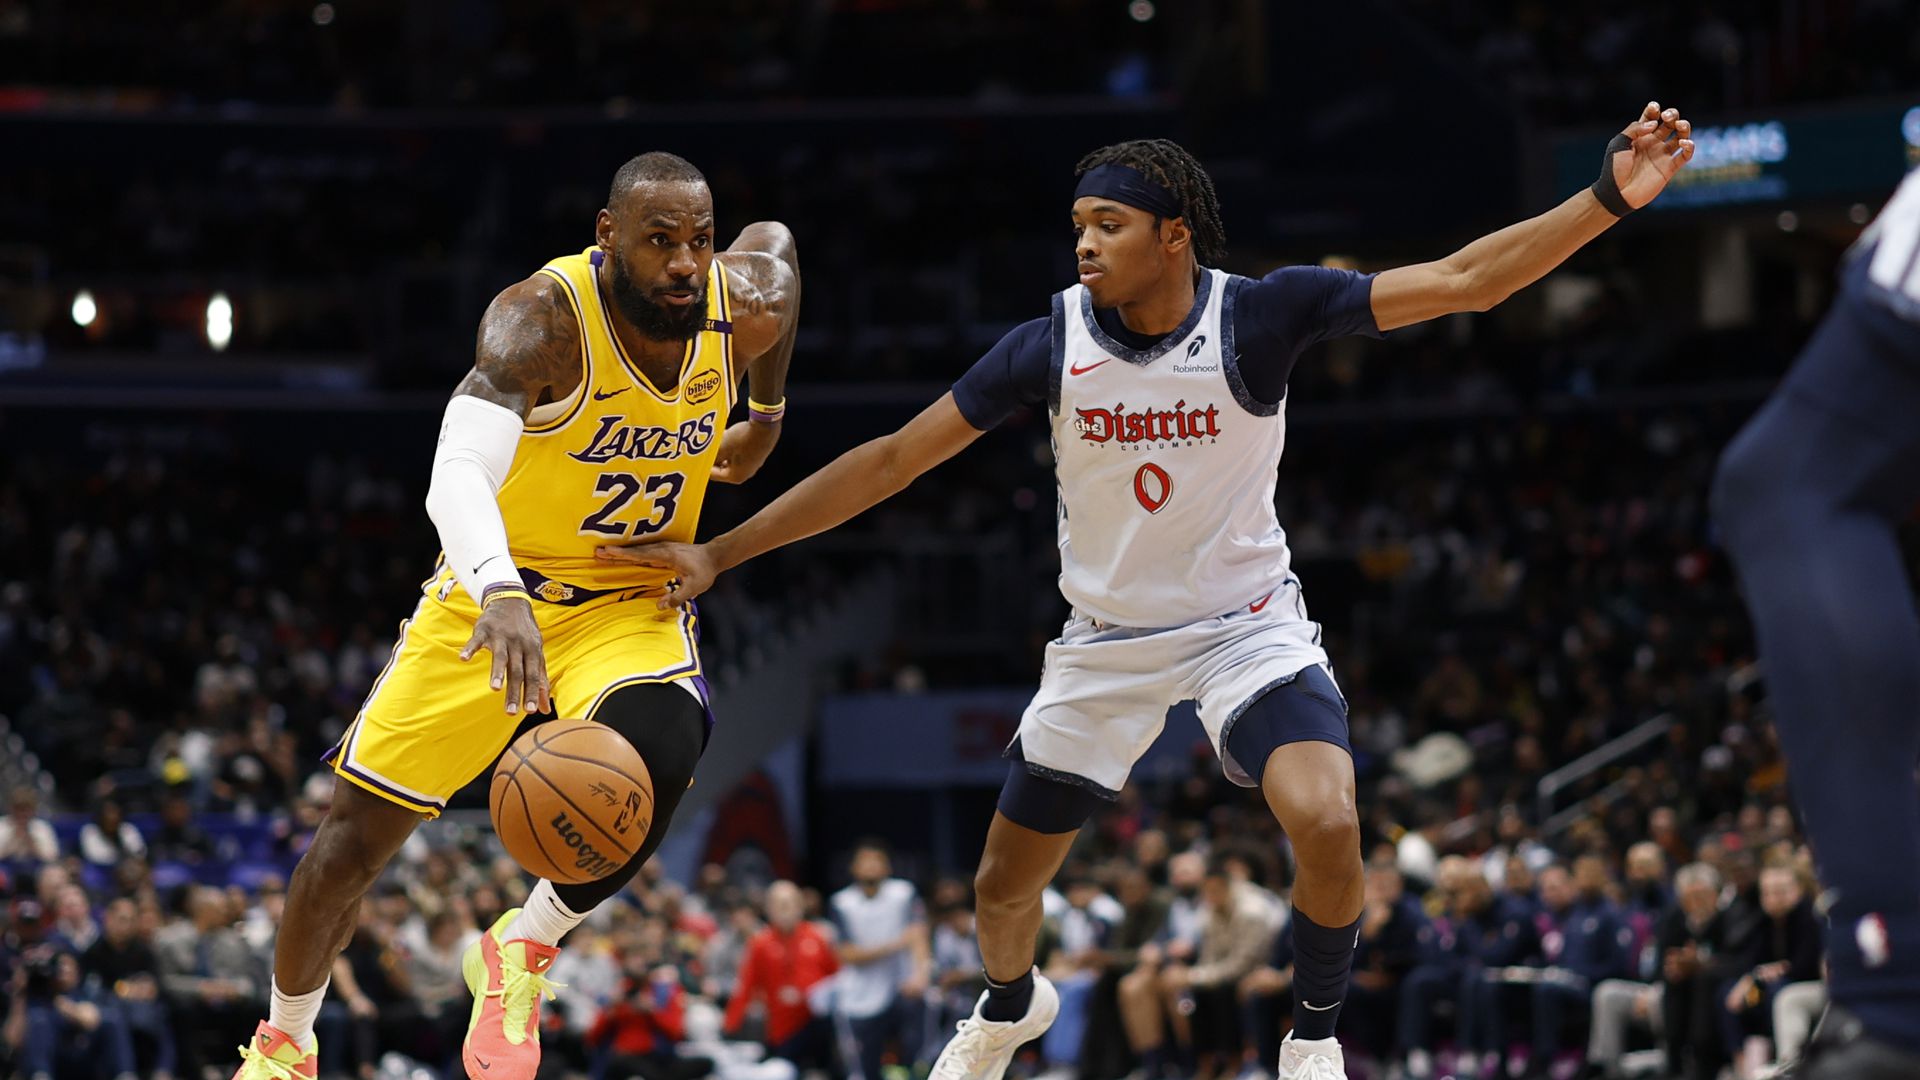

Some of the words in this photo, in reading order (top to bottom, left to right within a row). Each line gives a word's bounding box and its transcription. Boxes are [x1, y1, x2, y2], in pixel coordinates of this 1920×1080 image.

[1173, 364, 1218, 373] Robinhood
[688, 377, 718, 396] bibigo
[566, 411, 716, 463] LAKERS
[1075, 418, 1101, 432] the
[1076, 400, 1221, 443] District
[1121, 438, 1216, 451] COLUMBIA
[1133, 462, 1174, 515] 0
[578, 471, 687, 538] 23
